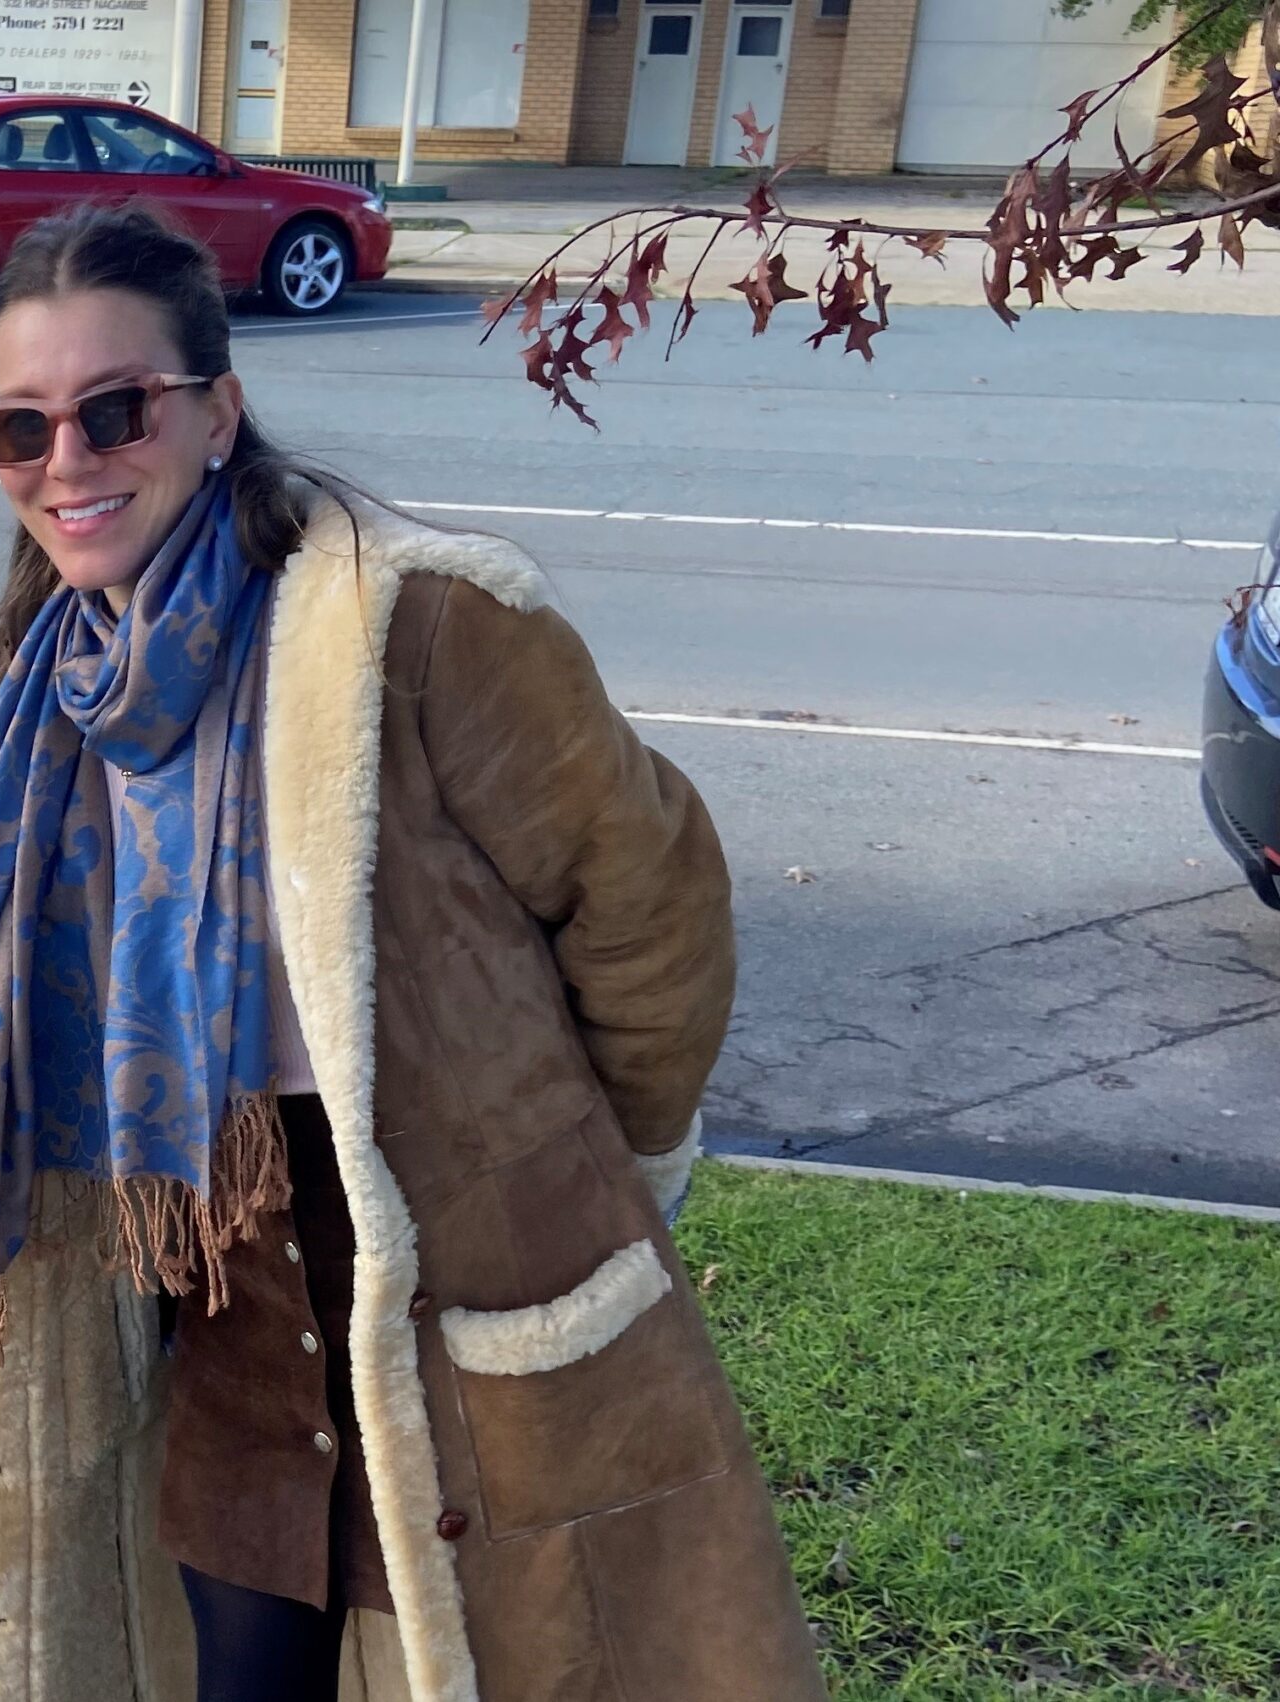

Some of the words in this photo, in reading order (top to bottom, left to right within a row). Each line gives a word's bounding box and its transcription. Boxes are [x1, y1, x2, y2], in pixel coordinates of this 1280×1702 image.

[52, 0, 91, 9] STREET
[53, 16, 85, 30] 5794
[93, 17, 124, 31] 2221
[10, 47, 66, 59] DEALERS
[73, 49, 101, 60] 1929
[88, 82, 121, 92] STREET
